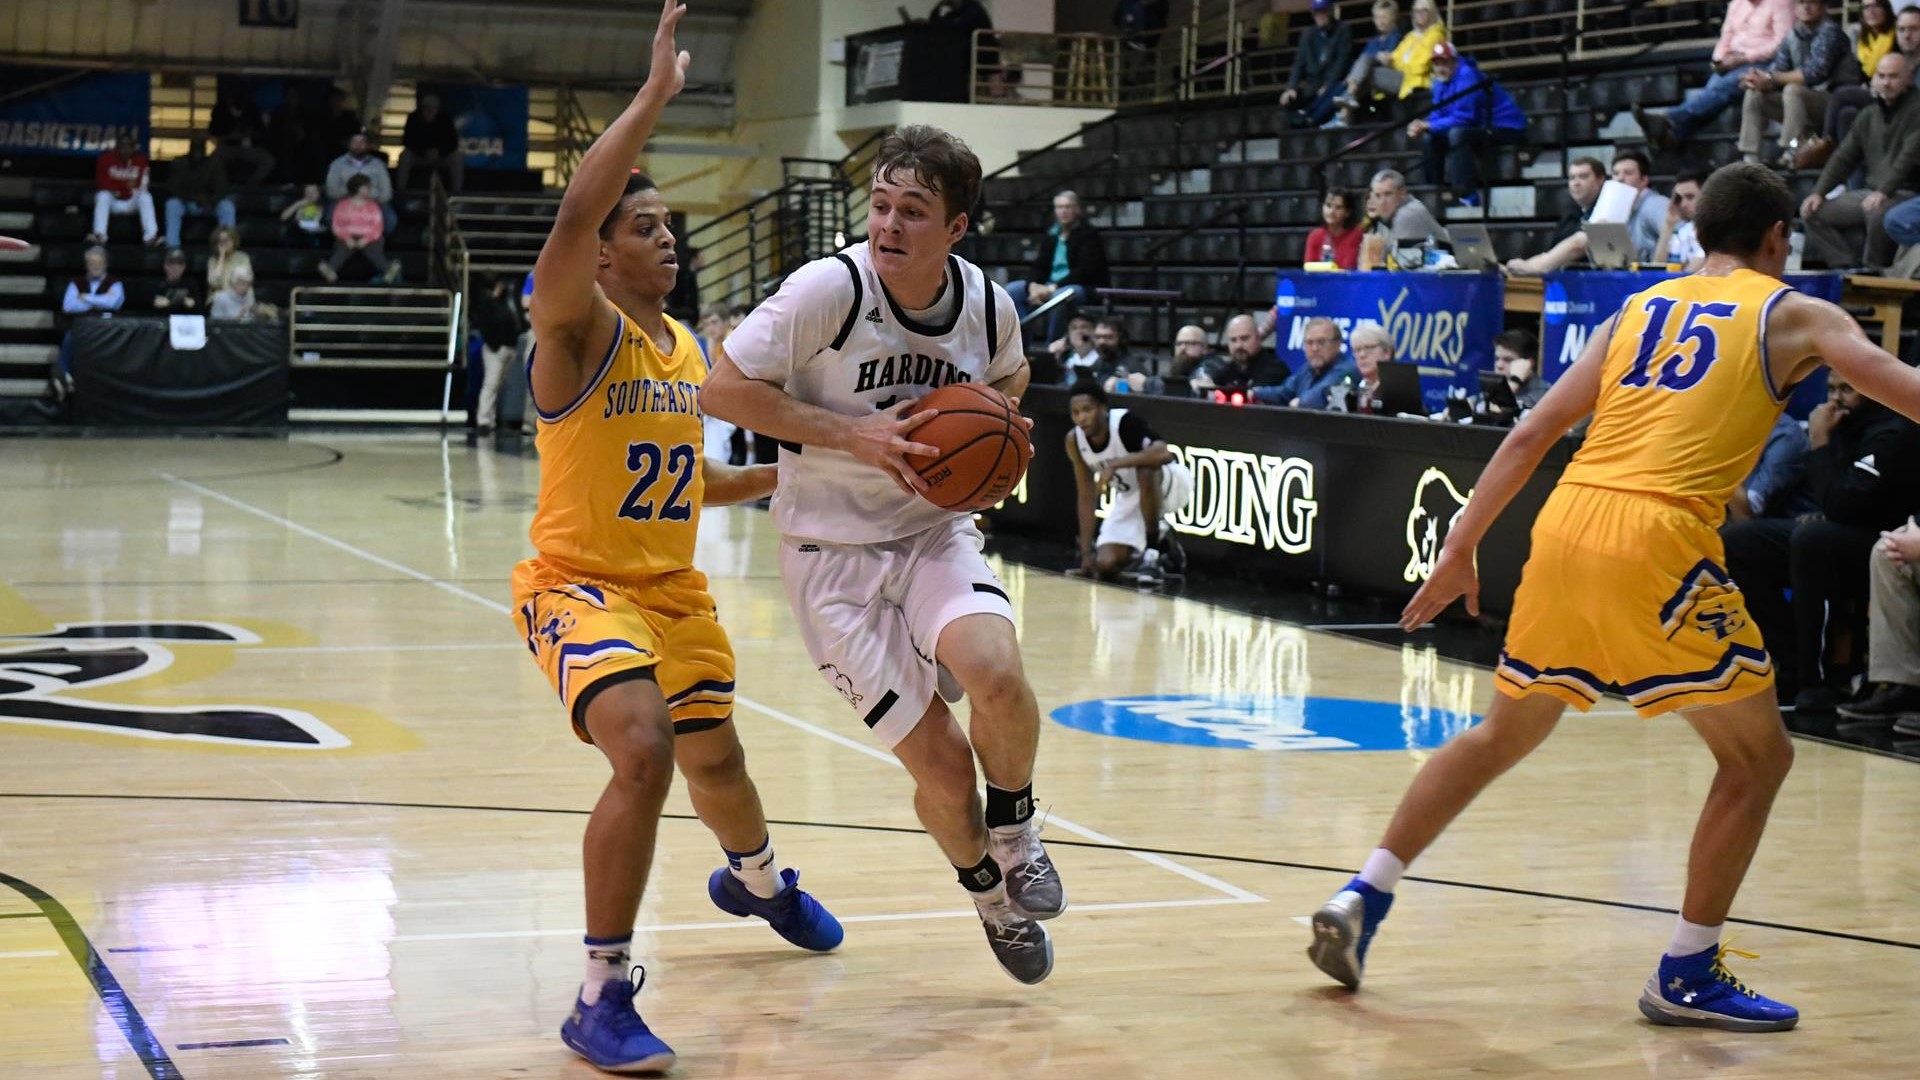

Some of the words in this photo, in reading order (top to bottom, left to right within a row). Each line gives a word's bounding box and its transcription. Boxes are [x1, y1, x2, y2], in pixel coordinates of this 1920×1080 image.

[1378, 287, 1469, 365] YOURS
[1620, 296, 1738, 391] 15
[618, 442, 696, 522] 22
[1094, 444, 1318, 554] DING
